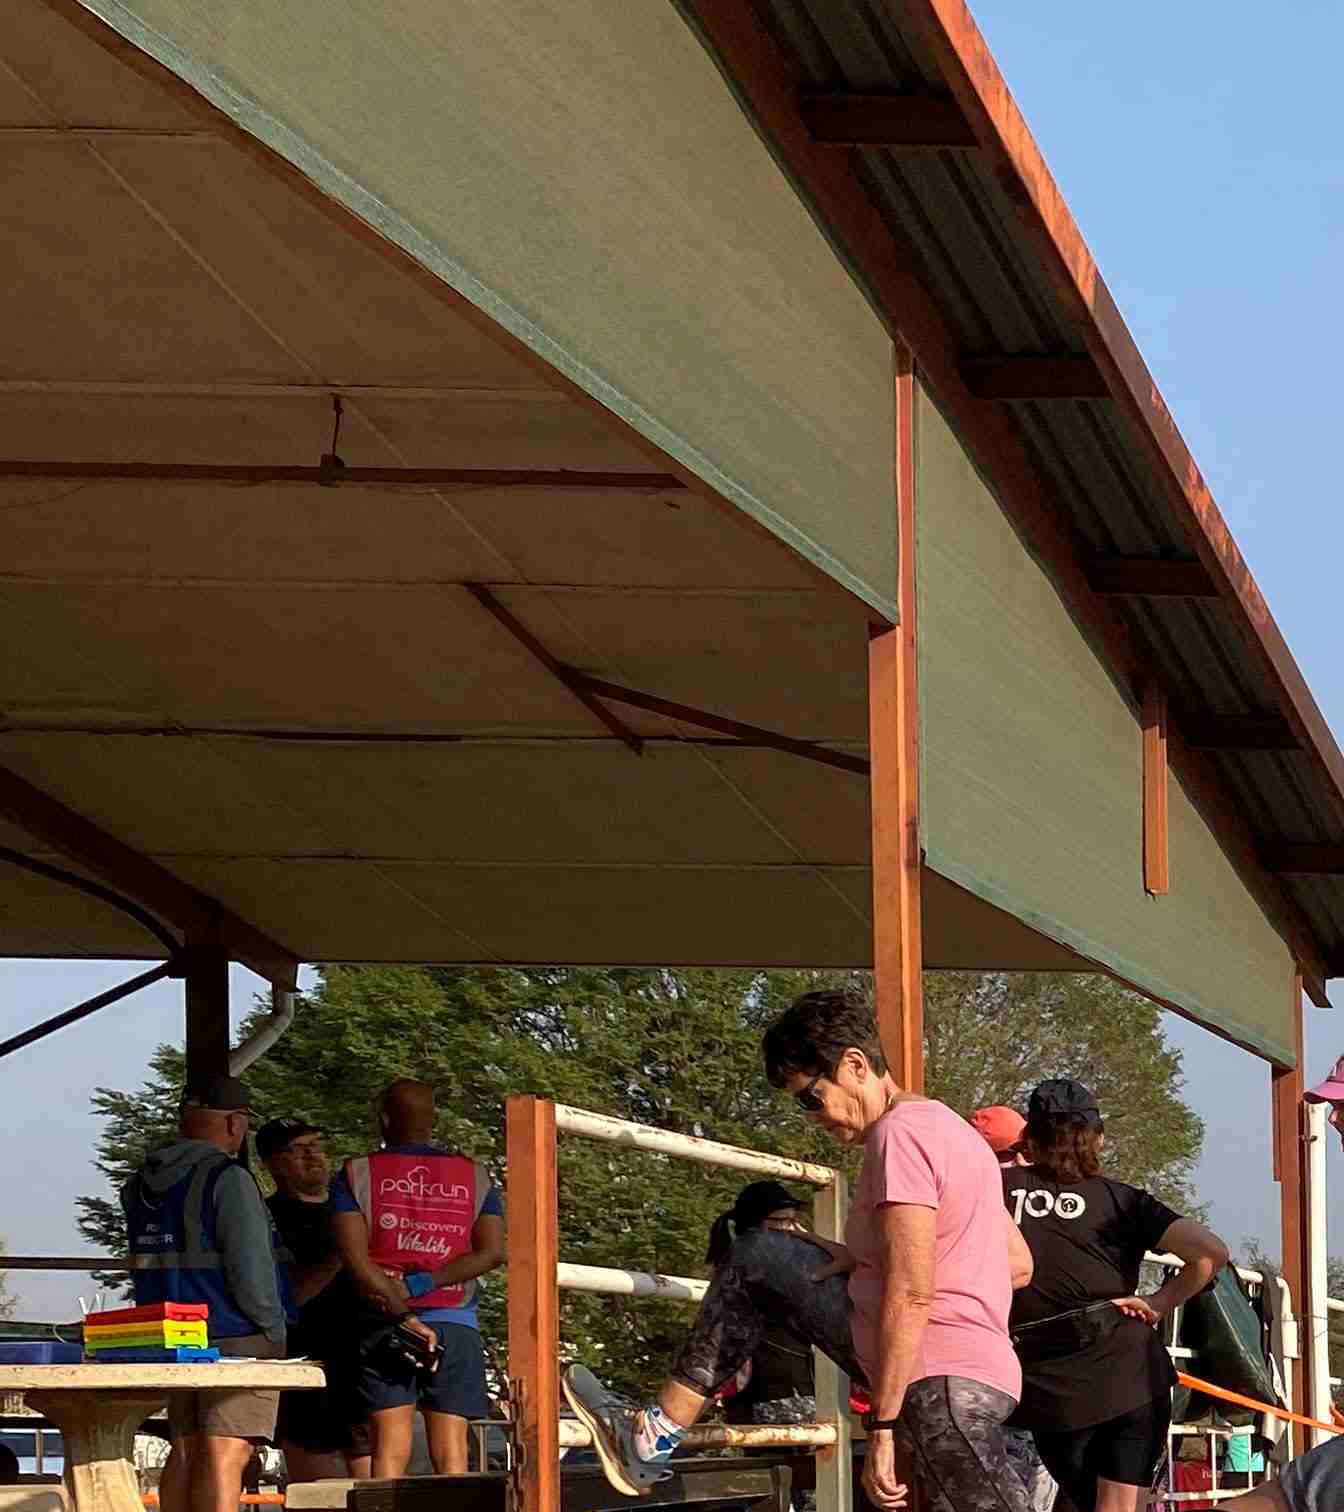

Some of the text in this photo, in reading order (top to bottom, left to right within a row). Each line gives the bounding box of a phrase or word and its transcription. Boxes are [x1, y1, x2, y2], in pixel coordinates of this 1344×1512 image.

[380, 1173, 469, 1200] parkrun
[1011, 1189, 1085, 1225] 100
[400, 1217, 466, 1236] Discovery
[397, 1231, 452, 1259] Vitality
